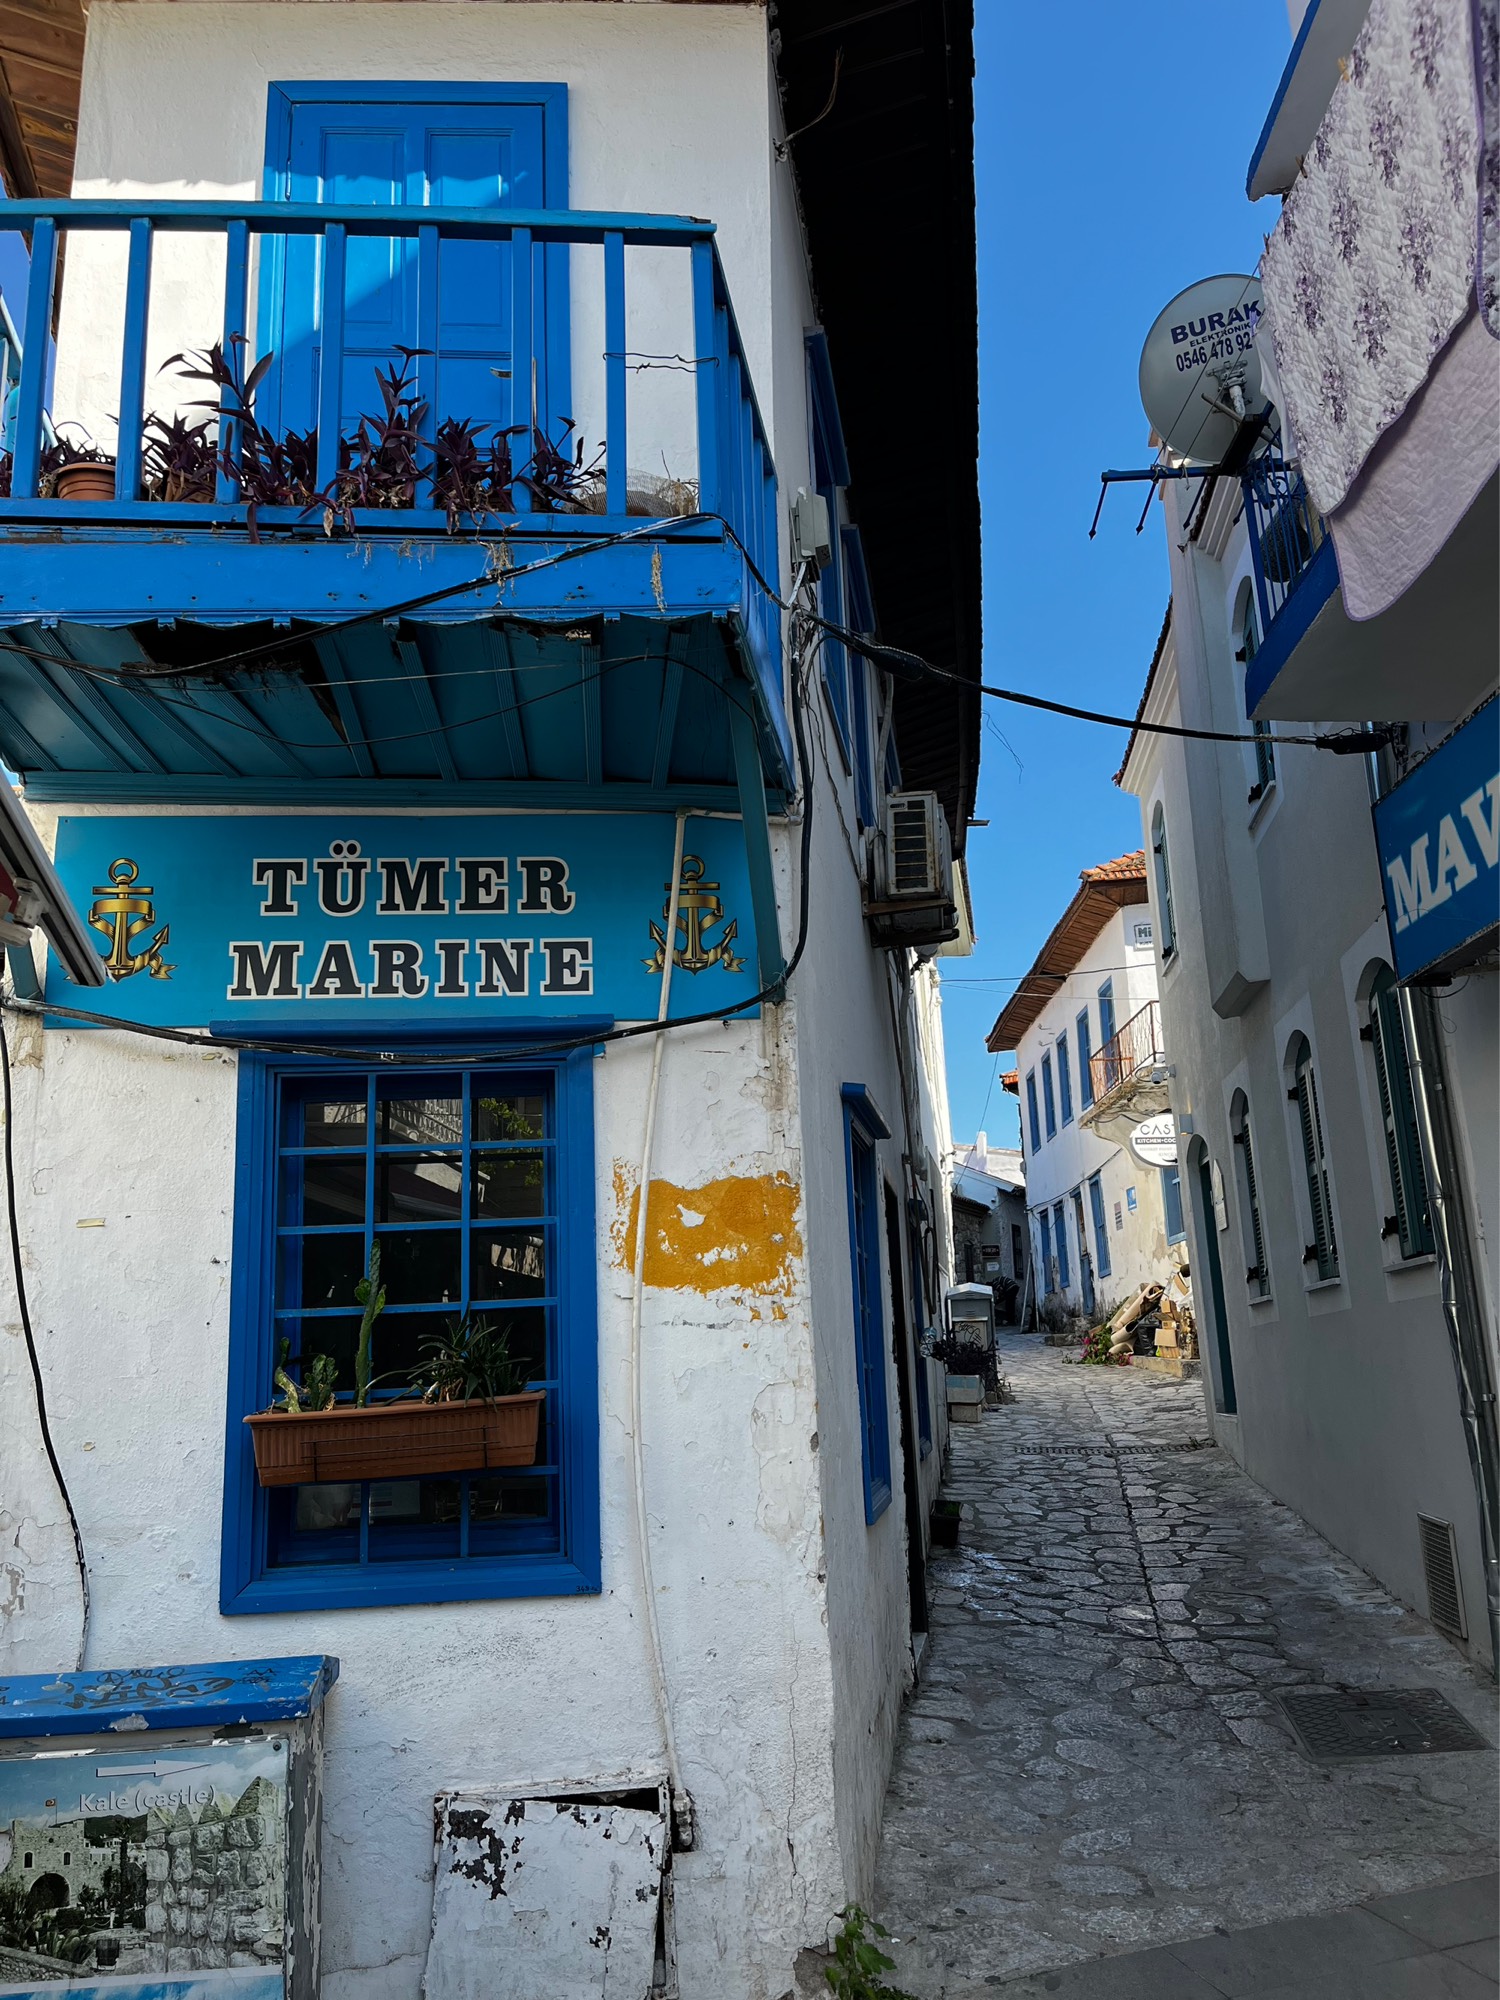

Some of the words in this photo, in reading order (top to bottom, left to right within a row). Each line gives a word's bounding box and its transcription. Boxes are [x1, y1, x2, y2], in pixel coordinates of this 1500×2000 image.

[1170, 299, 1262, 345] BURAK
[1175, 346, 1207, 372] 0546
[1210, 337, 1234, 360] 478
[252, 839, 576, 917] TÜMER
[1386, 772, 1500, 934] MAV
[227, 937, 594, 1000] MARINE
[79, 1790, 128, 1813] Kale
[134, 1784, 216, 1813] (castle)
